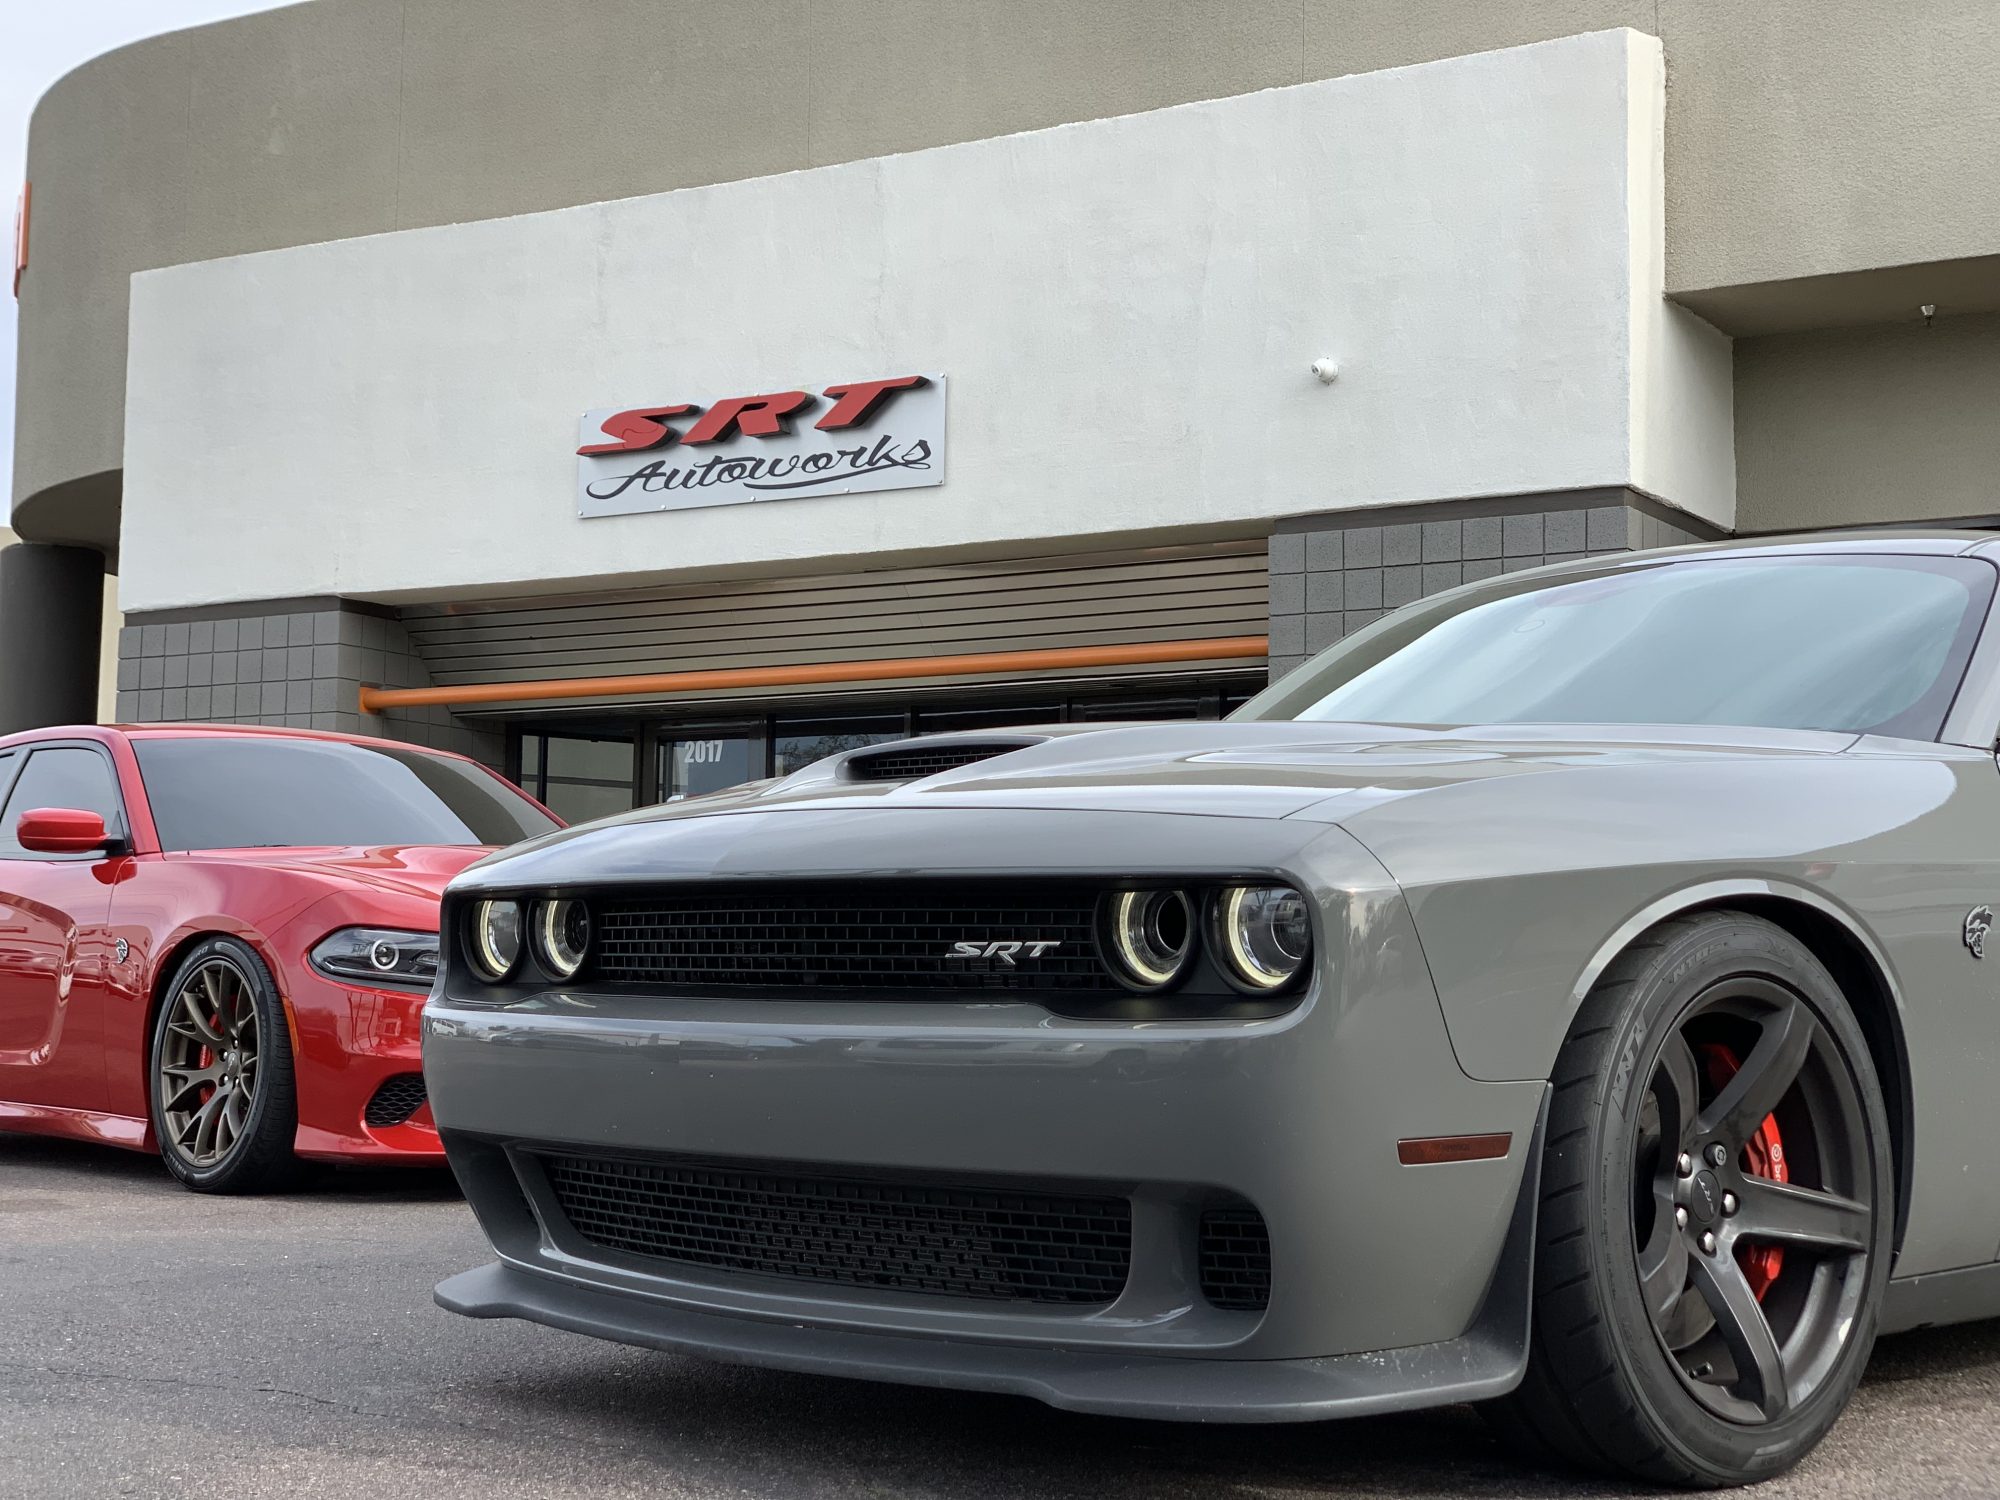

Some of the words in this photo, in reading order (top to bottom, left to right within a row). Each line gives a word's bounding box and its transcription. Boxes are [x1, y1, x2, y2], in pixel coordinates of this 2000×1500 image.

[576, 375, 930, 457] SRT
[586, 434, 932, 500] Autoworks
[684, 740, 724, 763] 2017
[944, 941, 1061, 965] SRT
